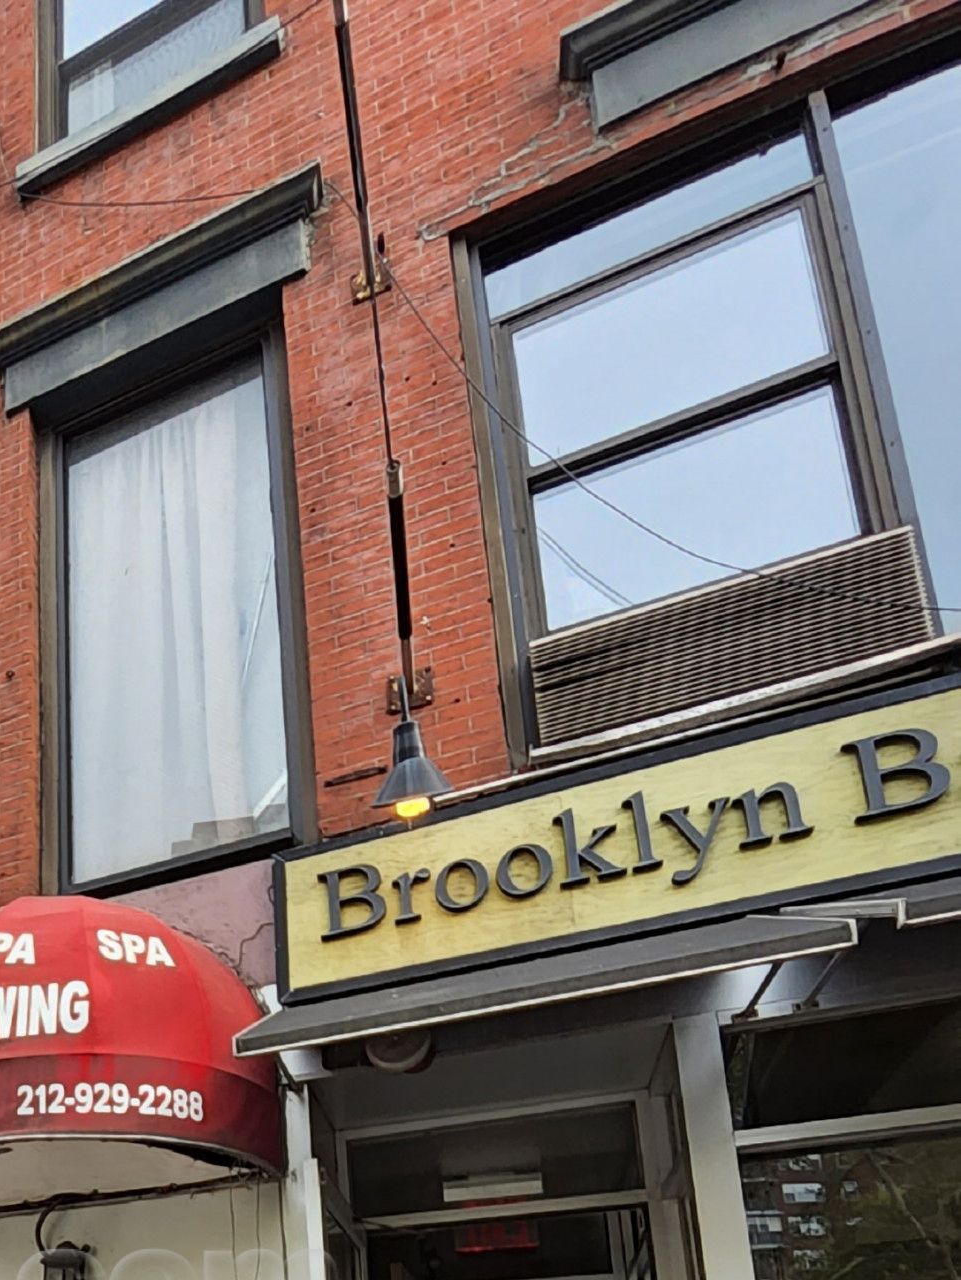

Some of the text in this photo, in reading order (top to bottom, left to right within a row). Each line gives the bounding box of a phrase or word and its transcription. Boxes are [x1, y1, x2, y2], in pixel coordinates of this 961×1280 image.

[317, 781, 815, 943] Brooklyn
[95, 928, 177, 968] SPA
[16, 1081, 204, 1122] 212-929-2288
